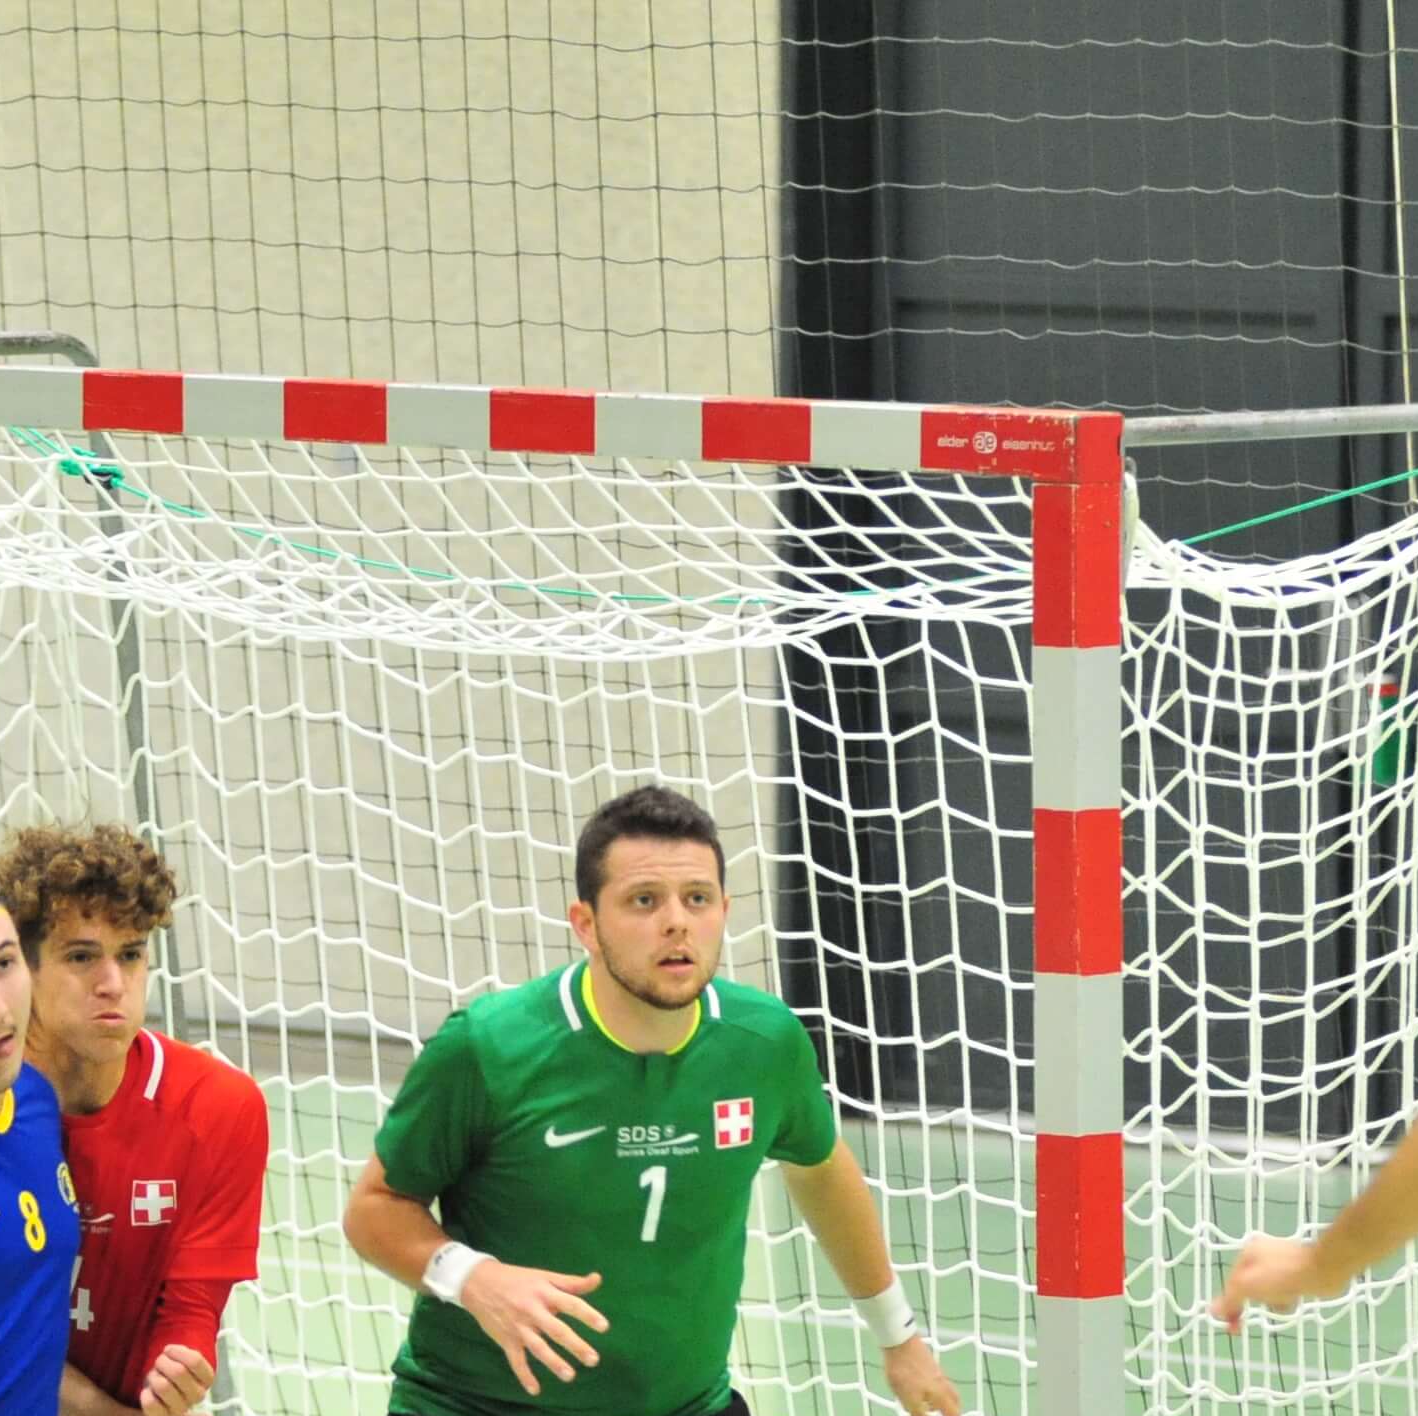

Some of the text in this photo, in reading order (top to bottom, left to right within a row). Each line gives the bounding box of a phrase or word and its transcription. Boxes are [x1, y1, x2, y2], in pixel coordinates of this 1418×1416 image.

[617, 1124, 661, 1143] SDS
[17, 1189, 47, 1253] 8
[638, 1165, 668, 1243] 1
